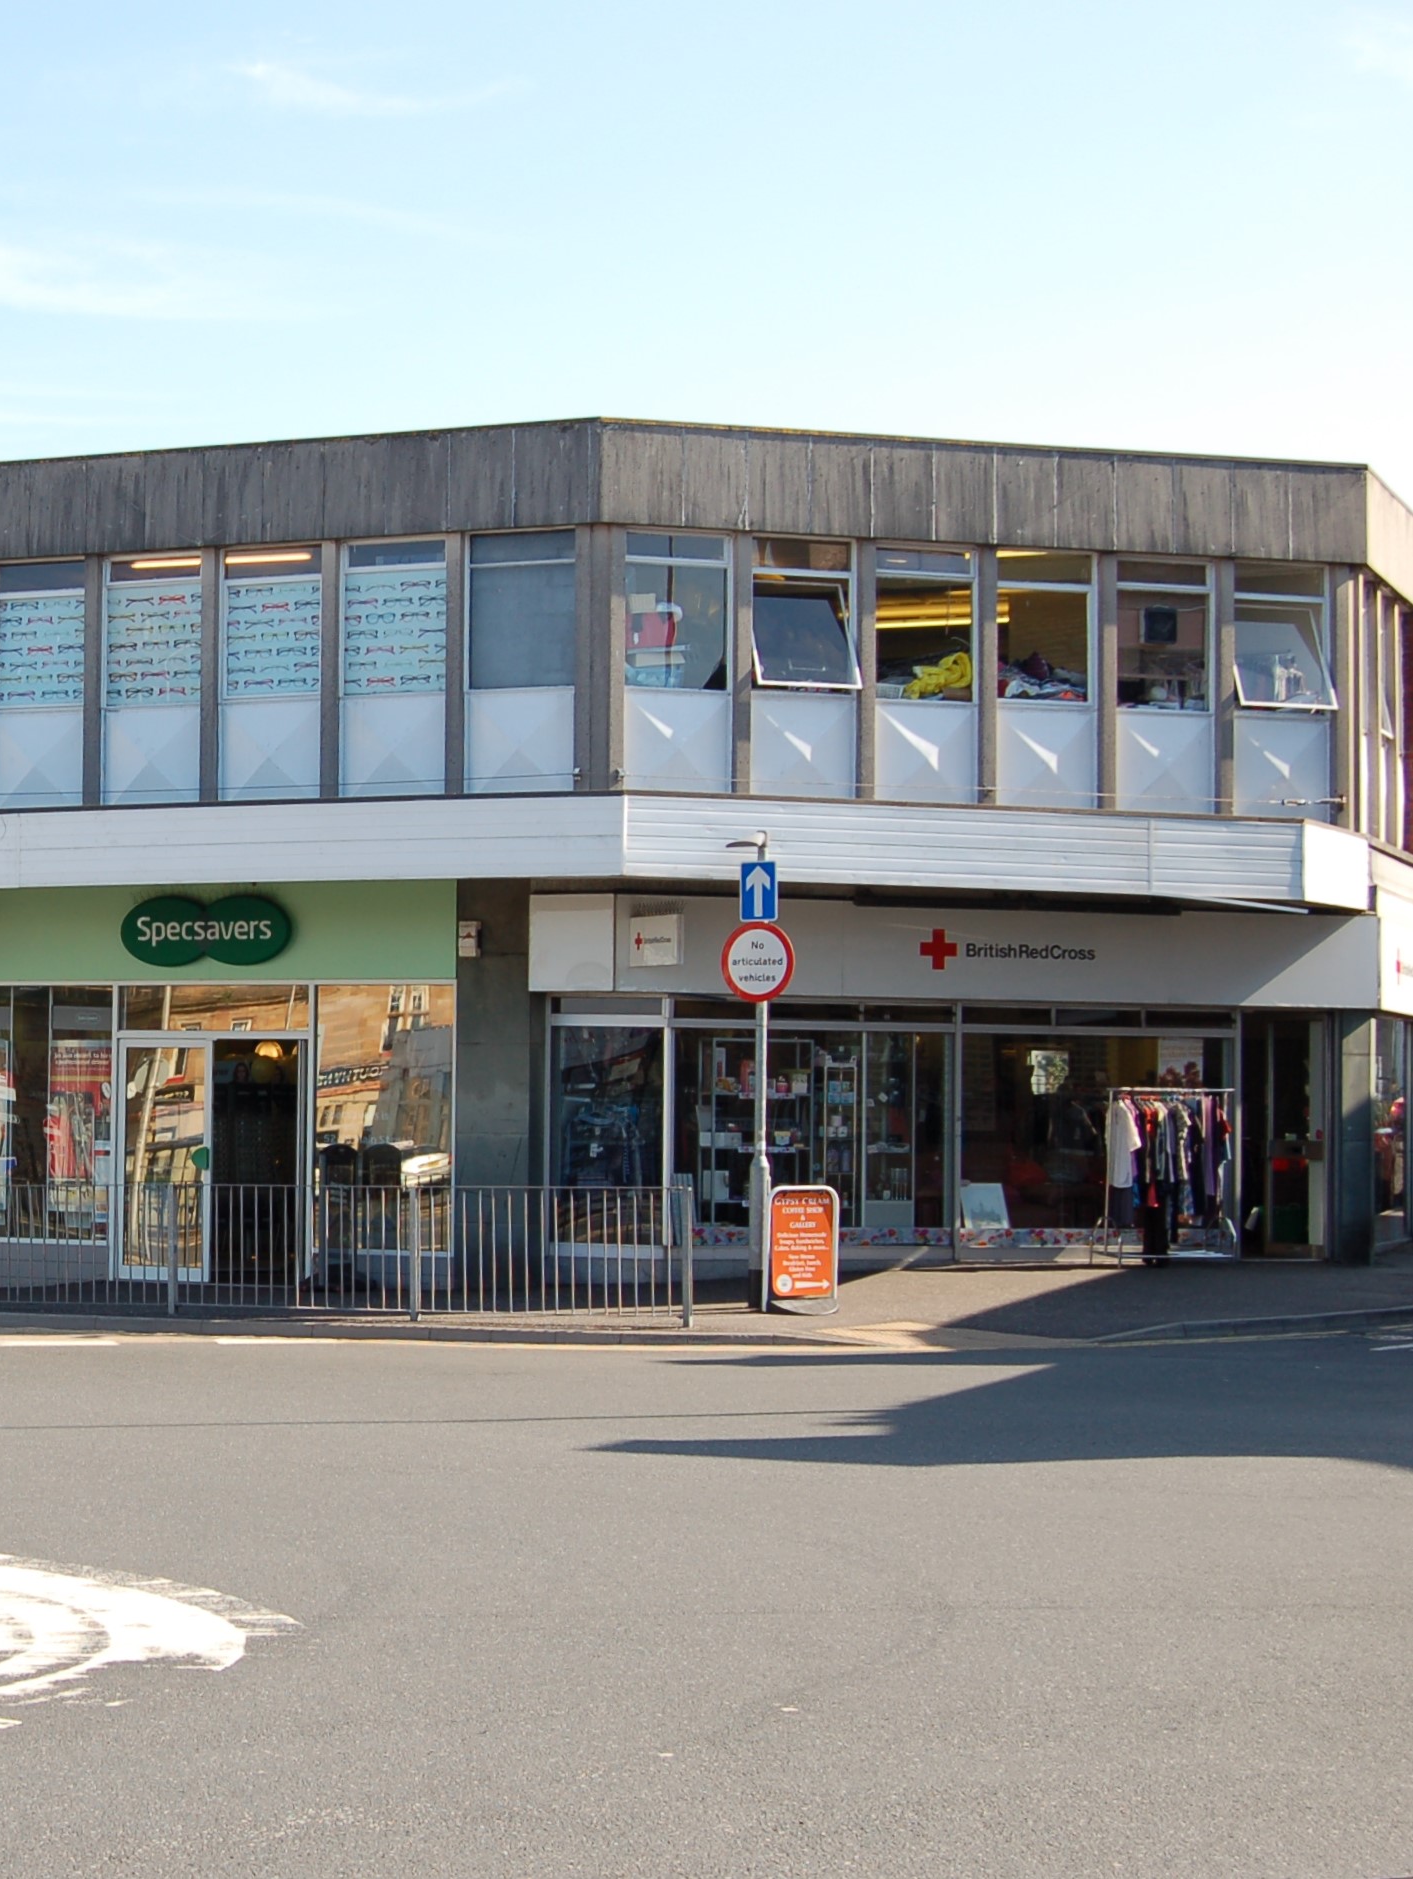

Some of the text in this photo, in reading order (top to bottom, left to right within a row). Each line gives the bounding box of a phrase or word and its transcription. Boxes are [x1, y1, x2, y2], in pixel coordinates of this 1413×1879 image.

[137, 916, 272, 947] Specsavers
[750, 940, 765, 950] No
[965, 942, 1096, 961] BritishRedCross
[731, 956, 784, 967] articulated
[738, 973, 777, 983] vehicles
[801, 1197, 830, 1205] CREAM
